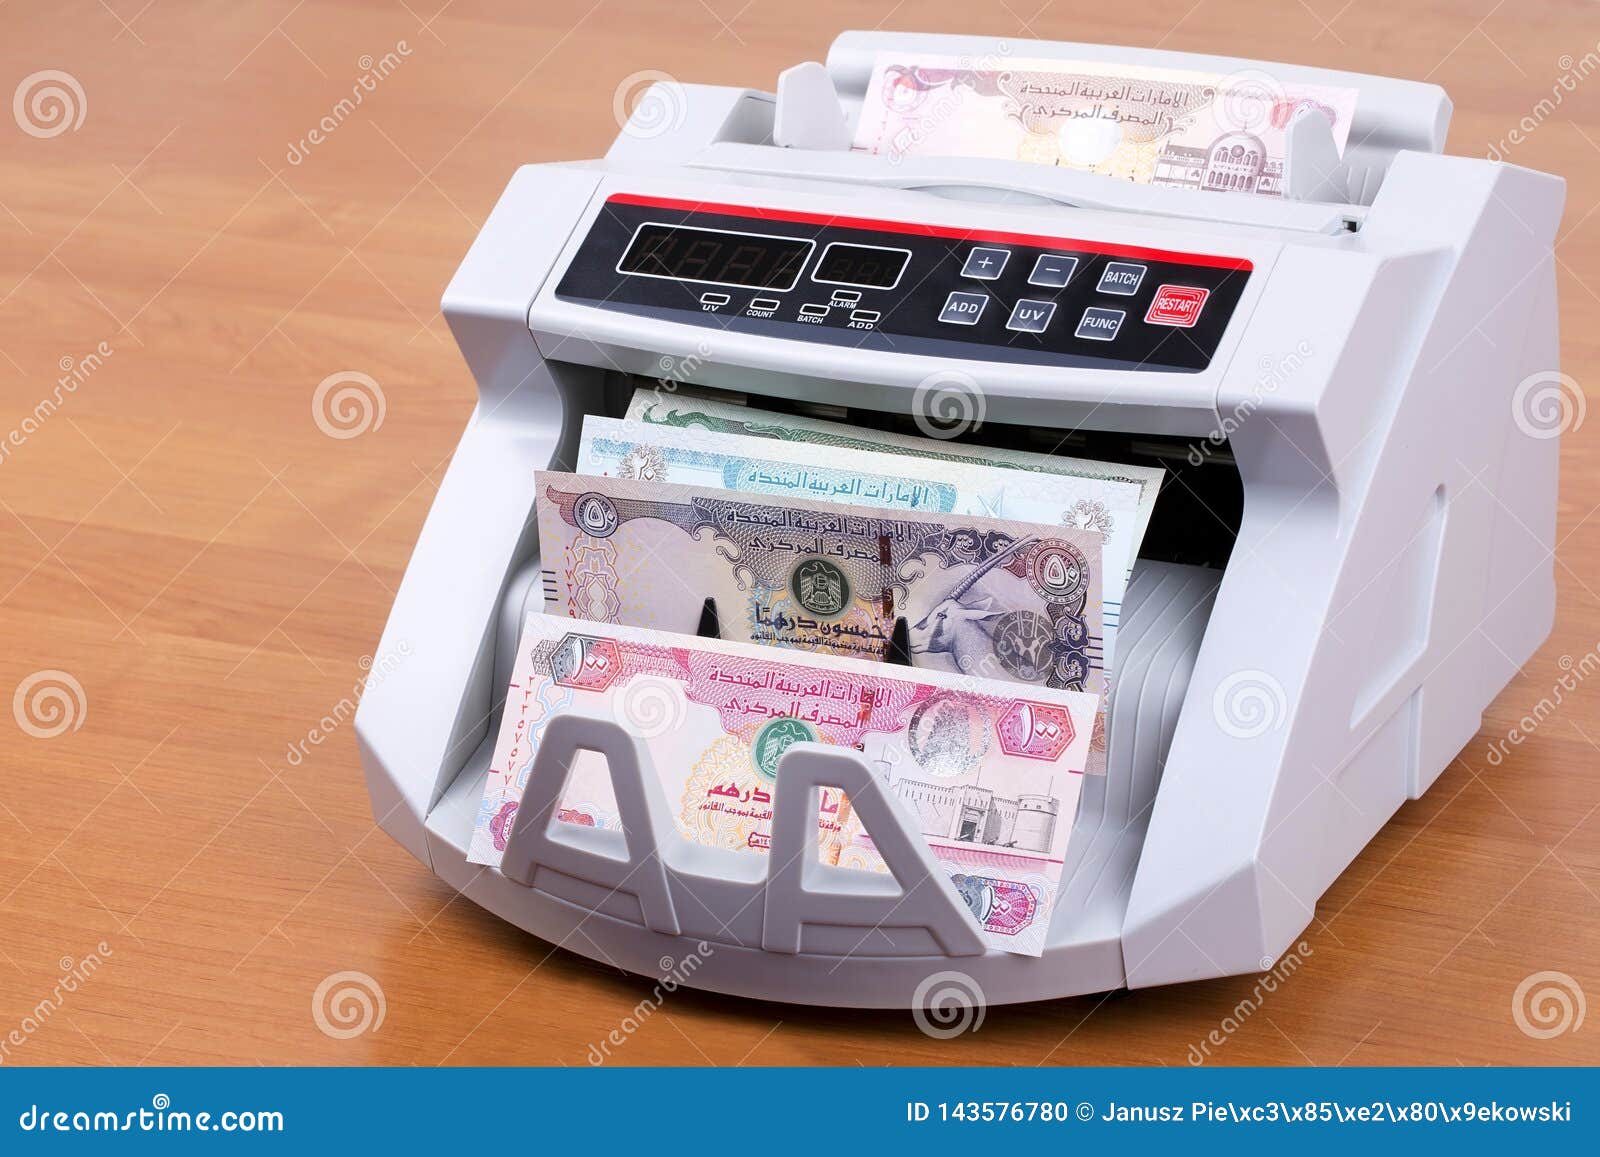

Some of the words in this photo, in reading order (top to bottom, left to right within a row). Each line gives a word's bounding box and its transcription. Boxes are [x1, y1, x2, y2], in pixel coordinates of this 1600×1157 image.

[1020, 80, 1080, 97] المتحدة
[1081, 81, 1131, 100] العربية
[1102, 104, 1163, 125] المصرف
[1105, 270, 1139, 286] BATCH
[702, 304, 719, 312] UV
[746, 309, 775, 318] COUNT
[828, 300, 857, 309] ALARM
[948, 301, 978, 314] ADD
[1157, 297, 1199, 313] RESTART
[797, 315, 824, 324] BATCH
[1019, 308, 1045, 321] UV
[1083, 316, 1118, 330] FUNC
[847, 321, 874, 330] ADD
[748, 464, 807, 489] المتحدة
[809, 473, 862, 496] العربية
[726, 505, 791, 527] المتحدة
[795, 511, 848, 534] العربية
[749, 536, 823, 556] المركزي
[709, 664, 775, 690] المتحدة
[776, 673, 830, 698] العربية
[724, 698, 800, 719] المركزي
[802, 703, 865, 729] المصرف
[707, 782, 771, 804] درهم
